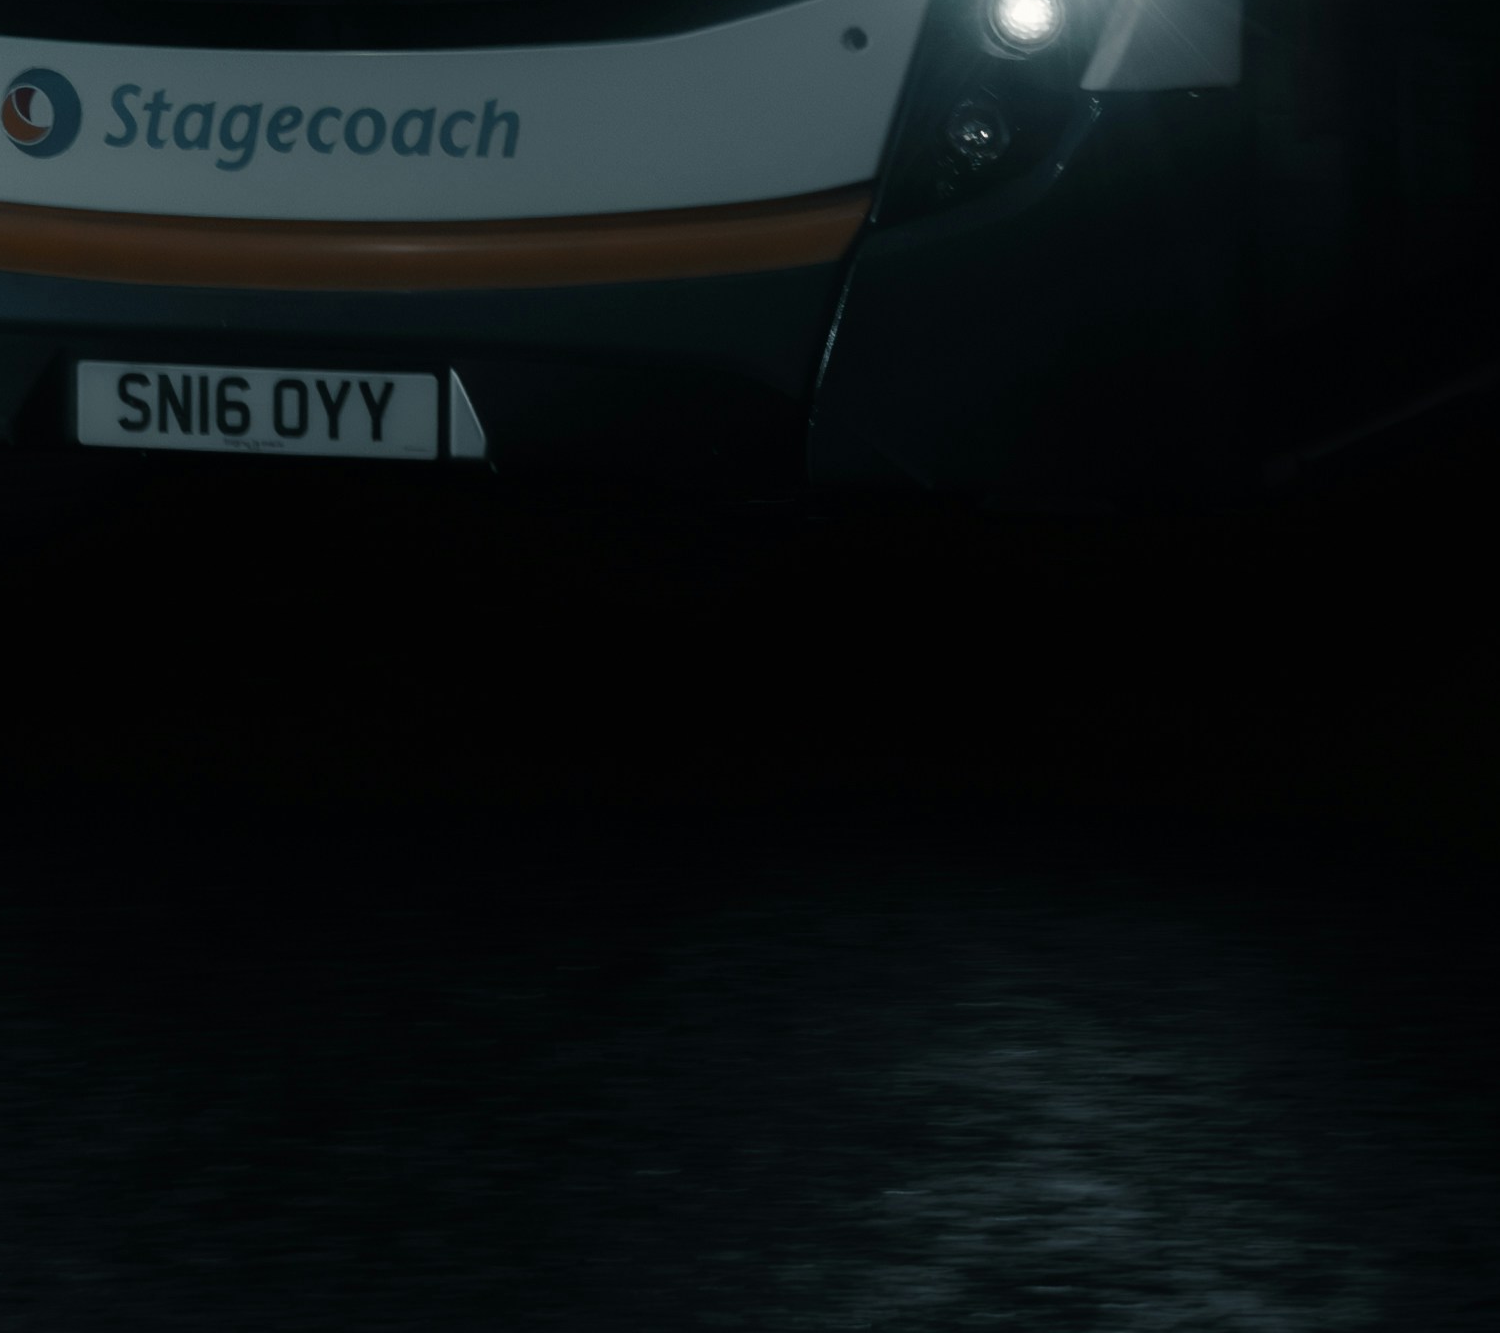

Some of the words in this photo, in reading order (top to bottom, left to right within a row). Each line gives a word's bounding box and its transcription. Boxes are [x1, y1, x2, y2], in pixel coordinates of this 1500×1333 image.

[103, 82, 521, 172] Stagecoach
[117, 372, 252, 437] SN16
[272, 378, 396, 442] OYY
